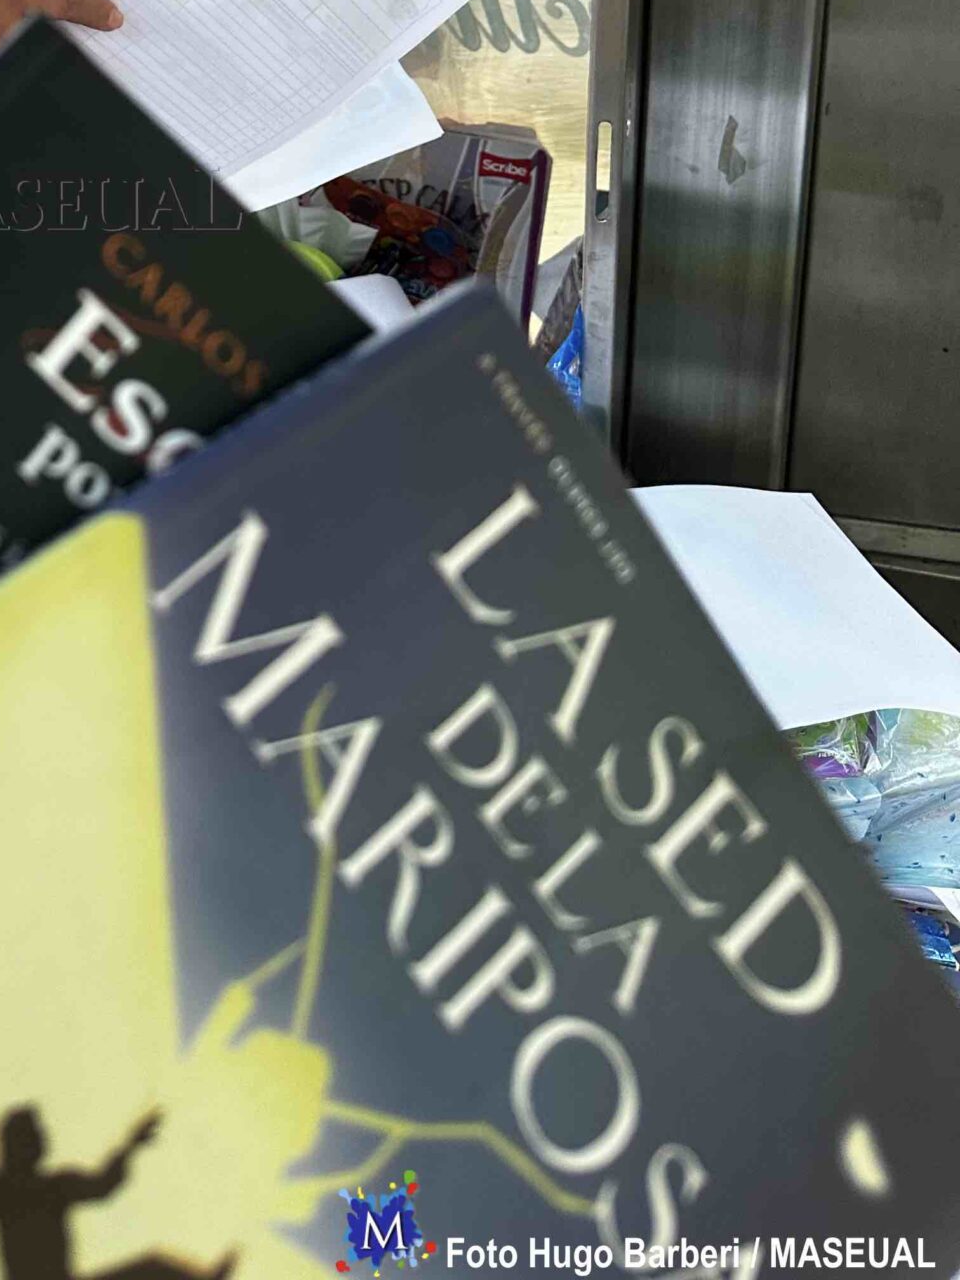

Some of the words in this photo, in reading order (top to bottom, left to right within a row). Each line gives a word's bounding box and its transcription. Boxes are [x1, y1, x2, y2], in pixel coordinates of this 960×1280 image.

[482, 159, 528, 177] Scribe
[100, 232, 270, 398] CARLOS
[426, 682, 568, 860] DE
[531, 828, 662, 1018] LA
[432, 482, 615, 744] LA
[598, 715, 844, 1018] SED
